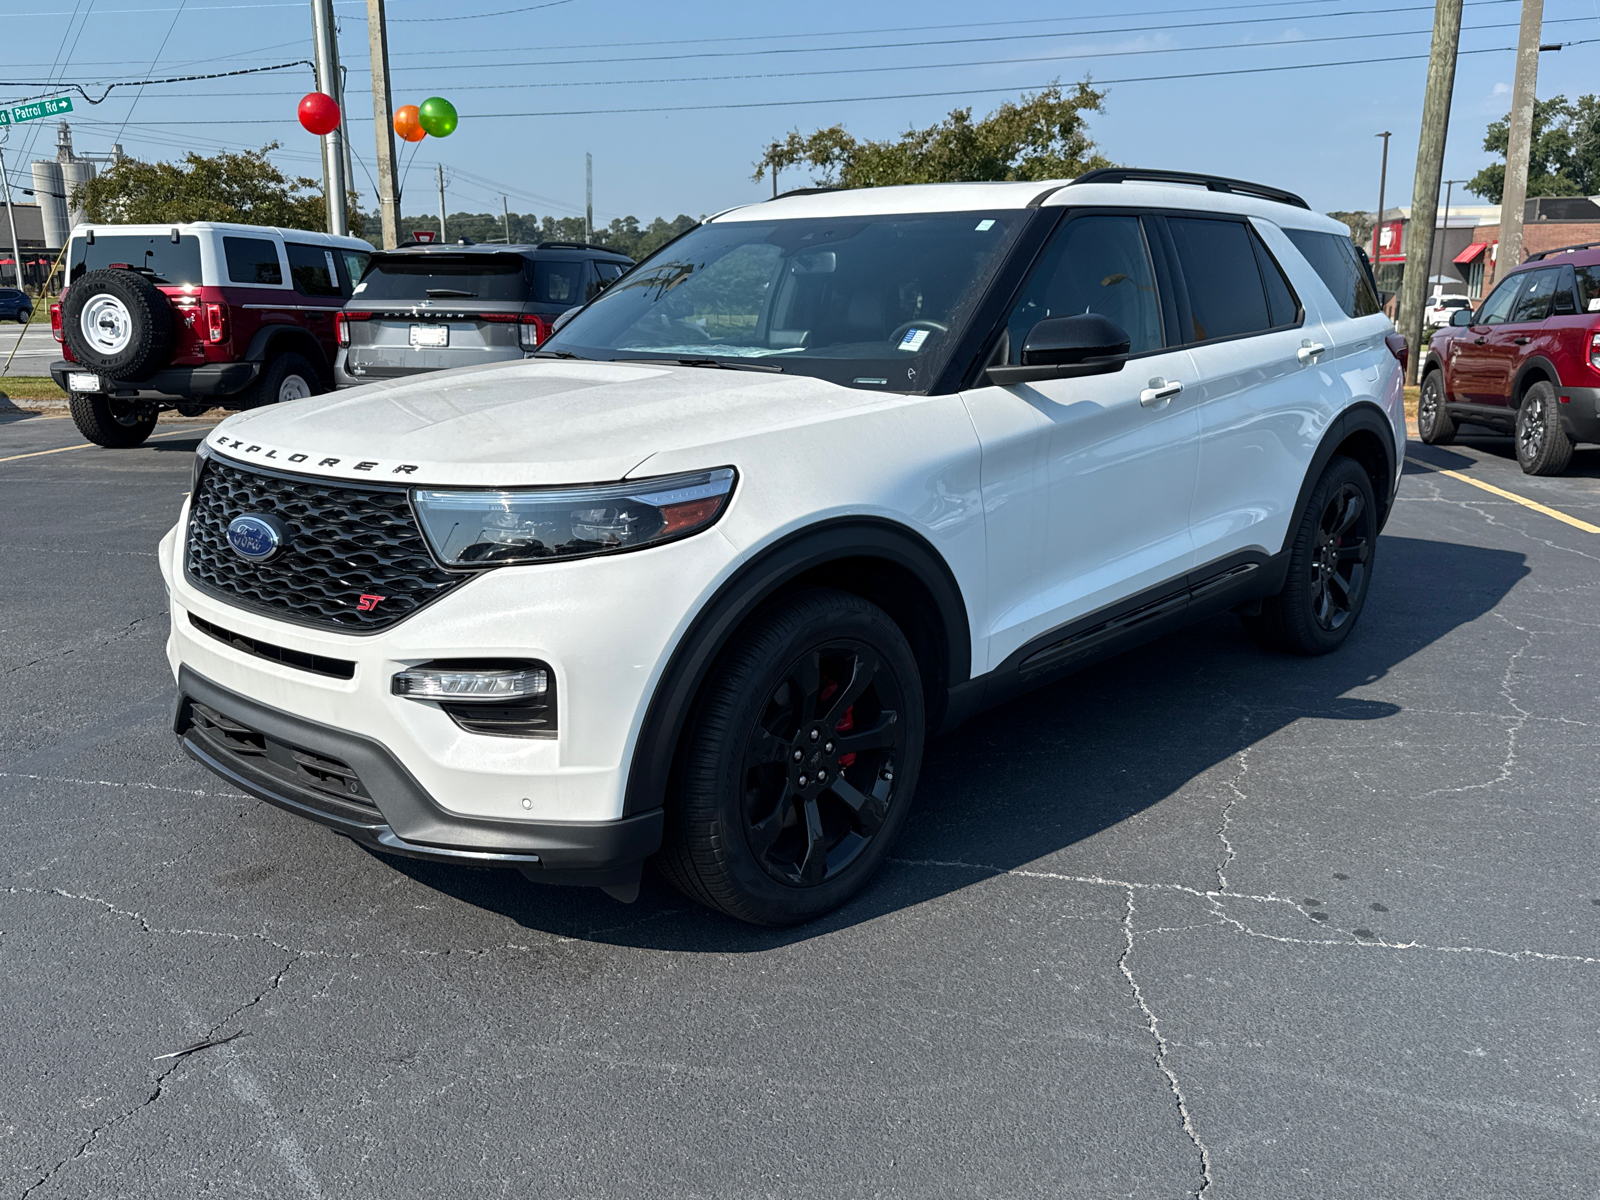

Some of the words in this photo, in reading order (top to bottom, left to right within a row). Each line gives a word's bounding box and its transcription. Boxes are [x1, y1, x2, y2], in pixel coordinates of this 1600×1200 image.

[0, 112, 7, 123] d
[45, 101, 58, 113] Rd
[216, 436, 419, 475] EXPLORER
[233, 524, 263, 551] Ford
[356, 594, 386, 611] ST
[1021, 646, 1101, 682] EXPLORER
